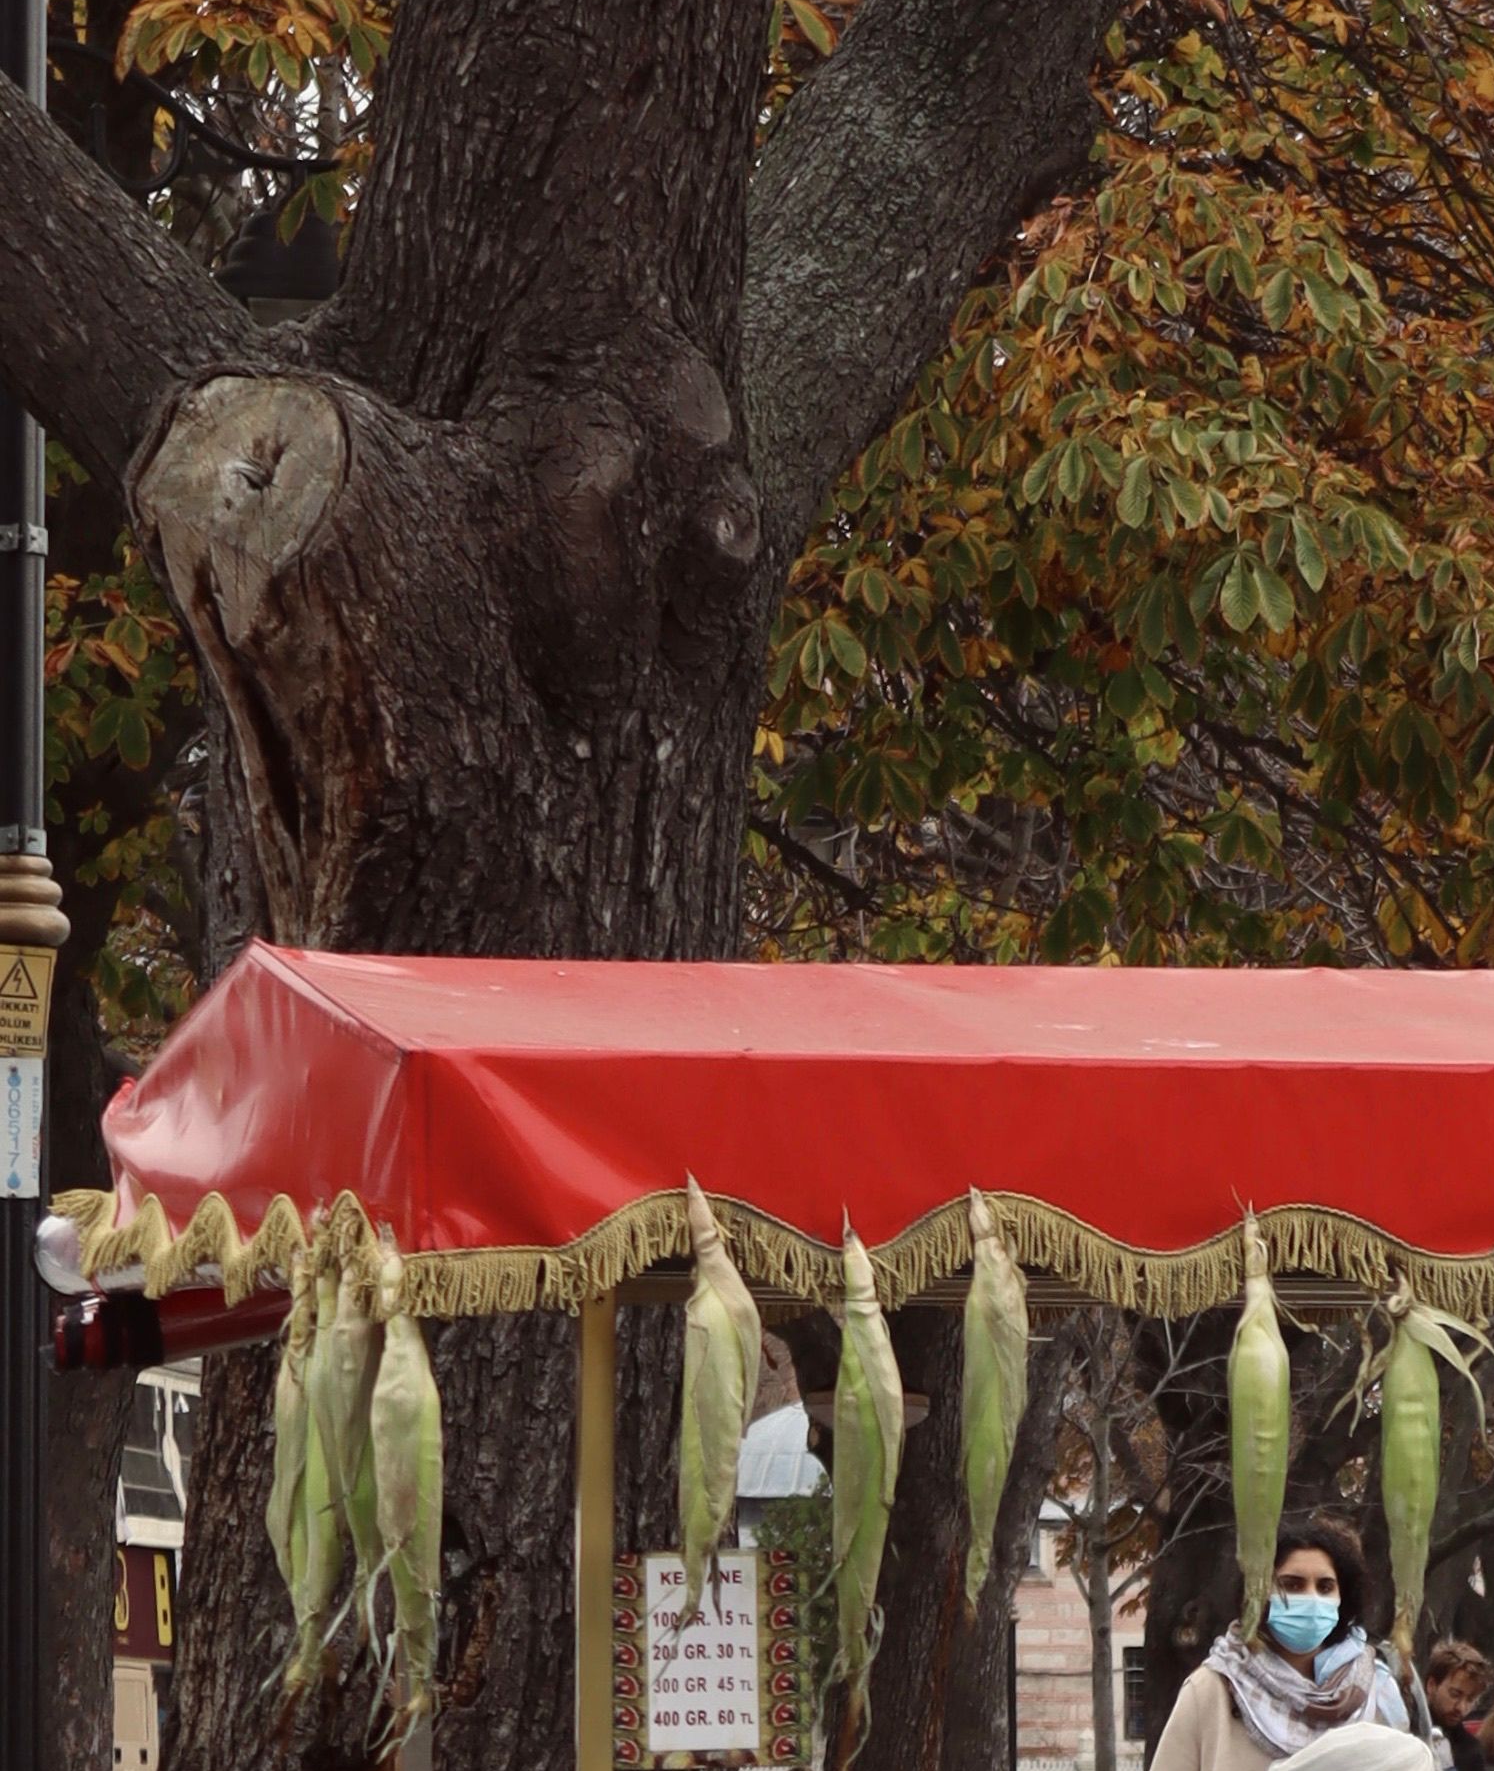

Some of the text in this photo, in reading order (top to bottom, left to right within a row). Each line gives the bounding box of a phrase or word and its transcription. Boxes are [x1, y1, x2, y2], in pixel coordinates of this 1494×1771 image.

[738, 1613, 753, 1626] TL
[685, 1643, 711, 1660] GR.
[717, 1643, 734, 1659] 30
[739, 1646, 753, 1659] TL
[653, 1677, 679, 1693] 300
[717, 1676, 734, 1691] 45
[740, 1679, 753, 1692] TL
[654, 1709, 754, 1727] 400 GR. 60 TL
